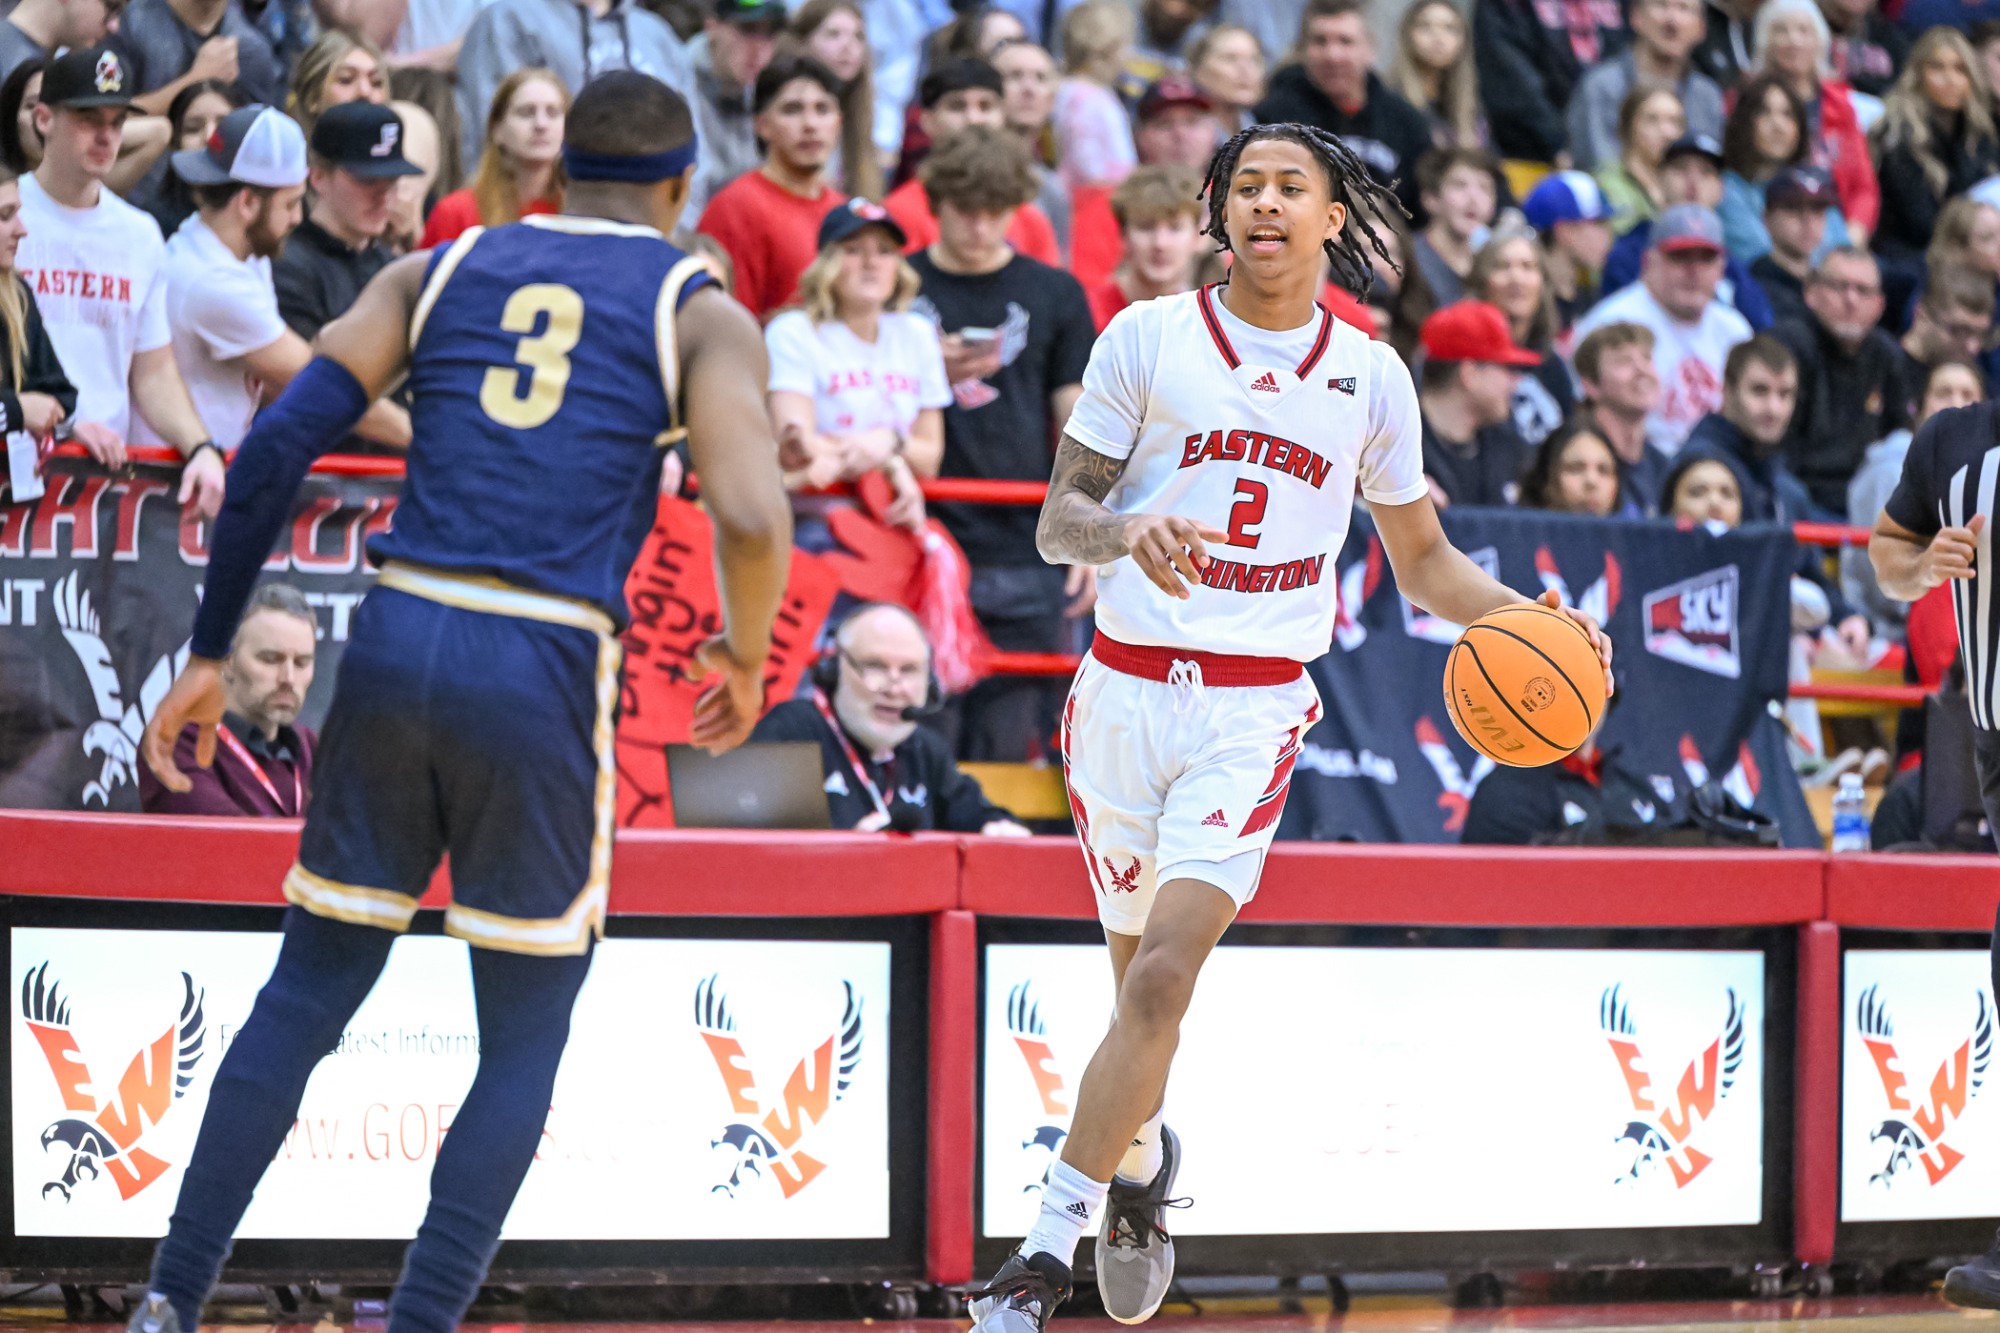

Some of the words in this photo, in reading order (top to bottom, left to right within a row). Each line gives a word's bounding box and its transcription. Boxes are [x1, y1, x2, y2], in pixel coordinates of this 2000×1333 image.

[479, 282, 585, 430] 3
[1250, 383, 1280, 393] adidas
[1338, 378, 1355, 390] SKY
[1177, 429, 1333, 490] EASTERN
[1225, 477, 1269, 549] 2
[1167, 545, 1327, 593] HINGTON
[1201, 819, 1229, 828] adidas
[329, 1030, 388, 1055] atest
